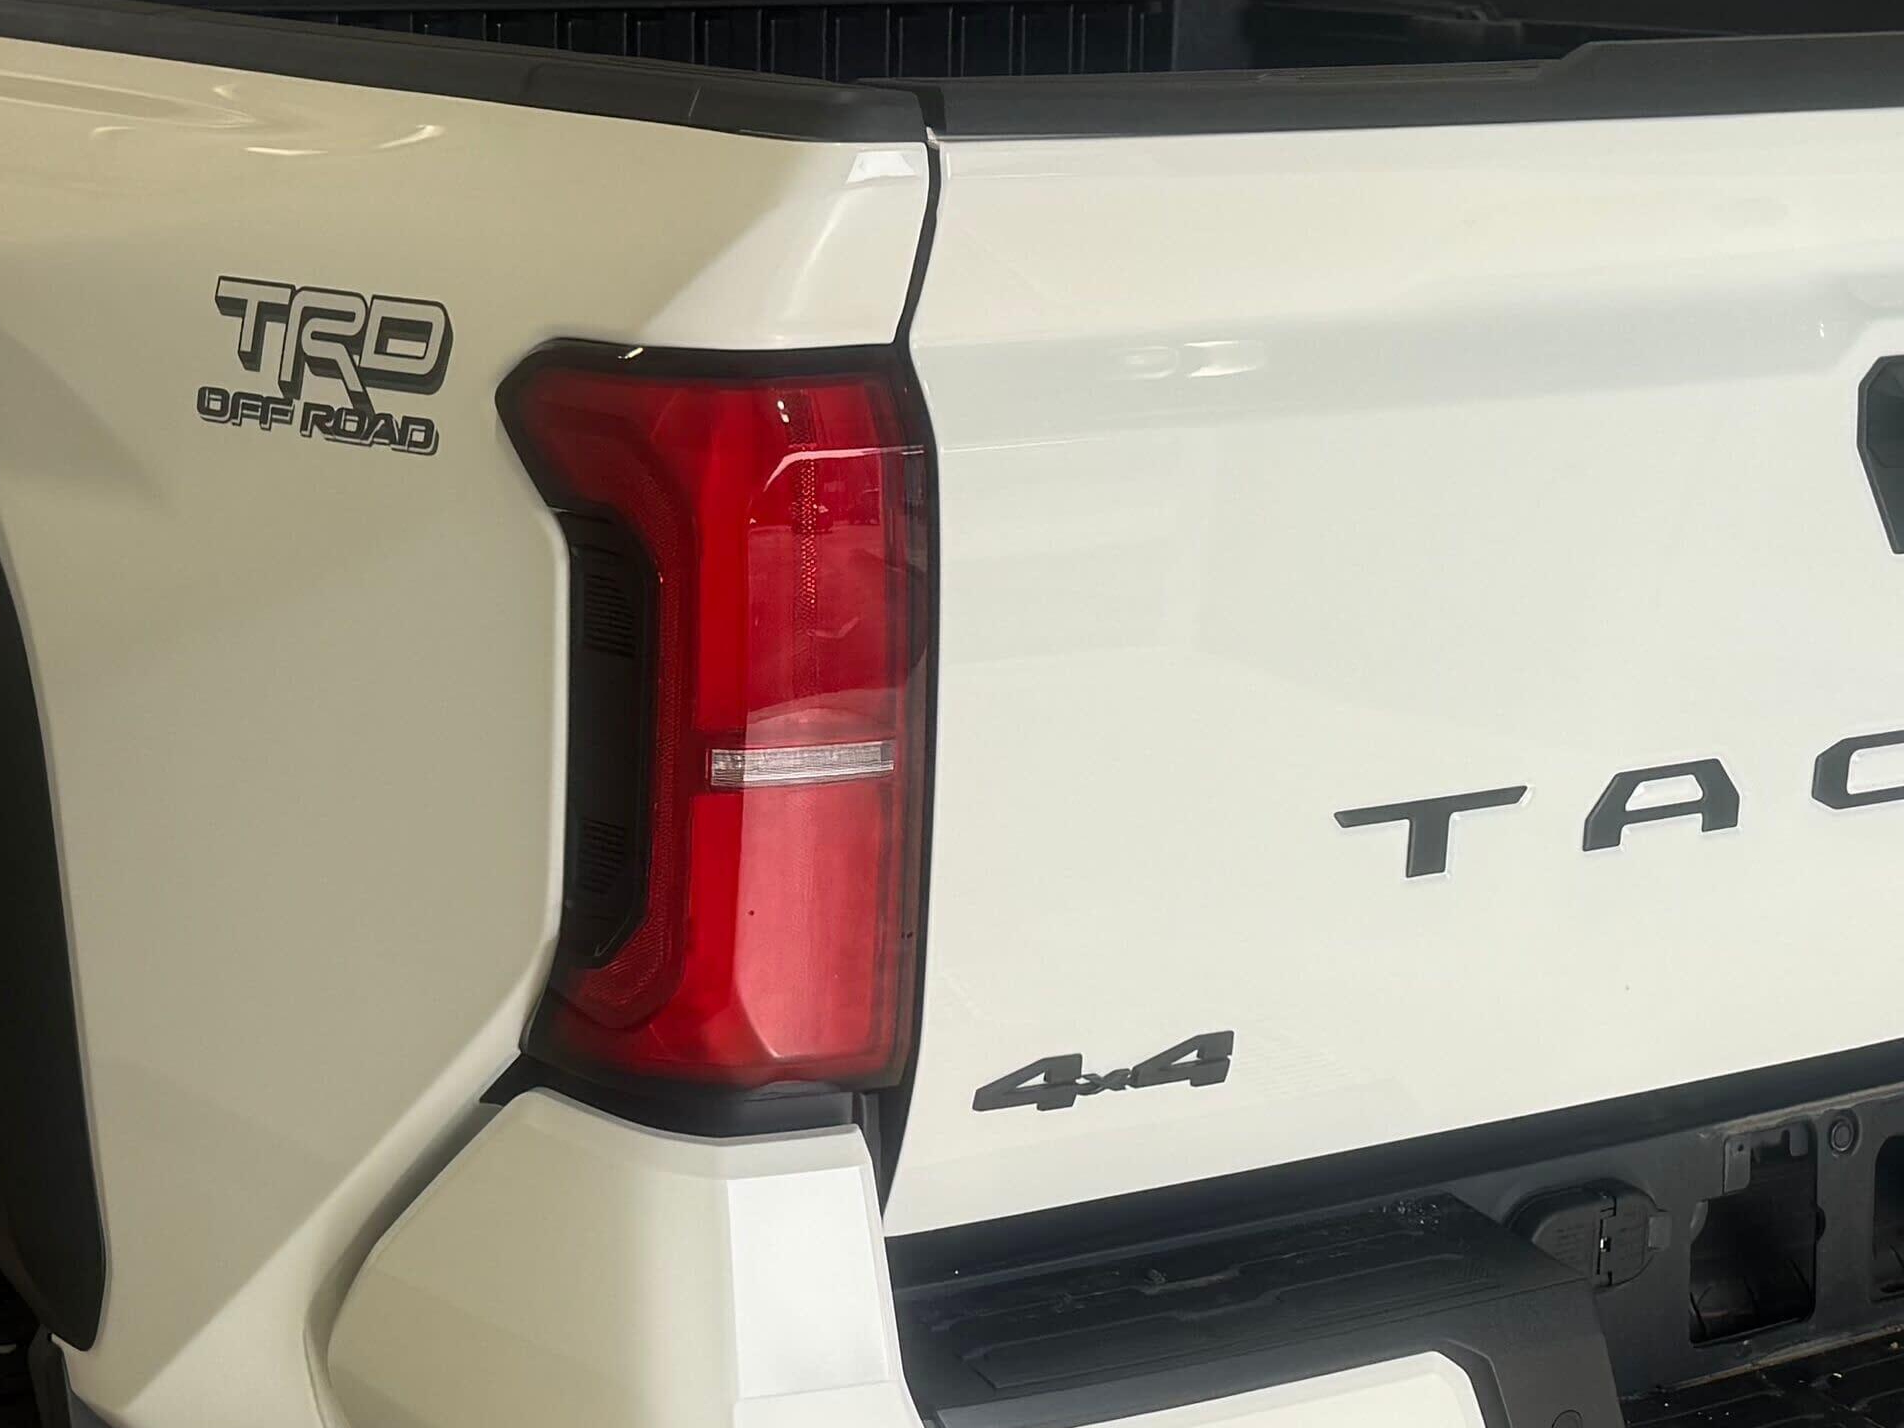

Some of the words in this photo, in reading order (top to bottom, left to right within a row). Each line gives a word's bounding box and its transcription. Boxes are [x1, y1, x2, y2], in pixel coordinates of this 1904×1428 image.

[215, 275, 453, 414] TRD
[197, 386, 293, 431] OFF
[300, 401, 439, 455] ROAD
